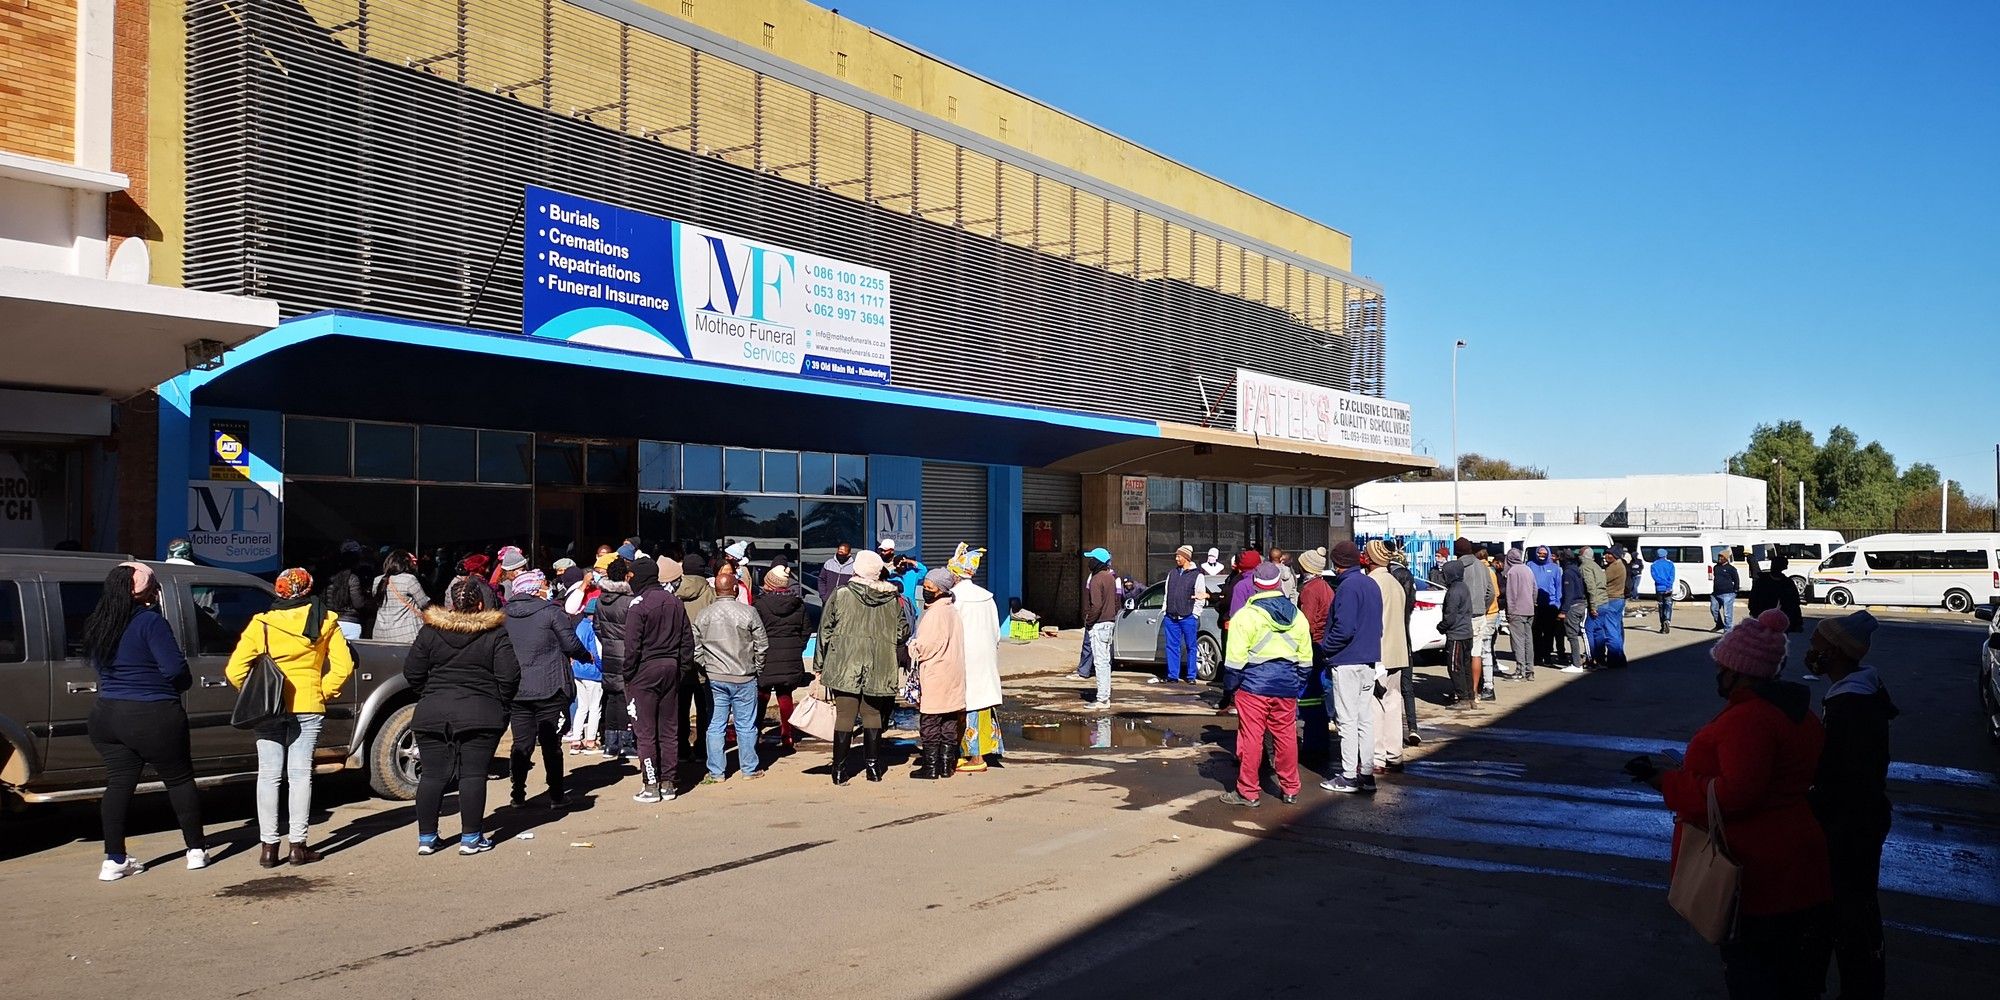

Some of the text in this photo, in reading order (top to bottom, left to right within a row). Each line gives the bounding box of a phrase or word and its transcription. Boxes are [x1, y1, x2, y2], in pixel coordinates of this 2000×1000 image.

[549, 203, 600, 230] Burials
[549, 227, 629, 259] Cremations
[549, 250, 641, 284] Repatriations
[696, 233, 795, 323] MF
[813, 265, 884, 291] 086 100 2255
[548, 273, 670, 311] Funeral Insurance
[813, 284, 884, 308] 053 831 1717
[814, 303, 885, 326] 062 997 3694
[695, 313, 796, 346] Motheo Funeral
[743, 341, 796, 365] Services
[811, 360, 819, 370] 39
[820, 361, 831, 372] Old
[832, 363, 846, 374] Main
[846, 365, 855, 375] Rd
[858, 366, 887, 380] Kimberley
[1242, 380, 1330, 443] PATEL'S
[1333, 411, 1339, 425] &
[1340, 412, 1368, 429] QUALITY
[1339, 398, 1411, 421] EXCLUSIVE CLOTHING
[222, 441, 237, 452] ADT
[188, 486, 272, 532] MF
[880, 503, 914, 532] MF
[188, 533, 272, 545] Motheo Funeral
[226, 545, 271, 556] Services
